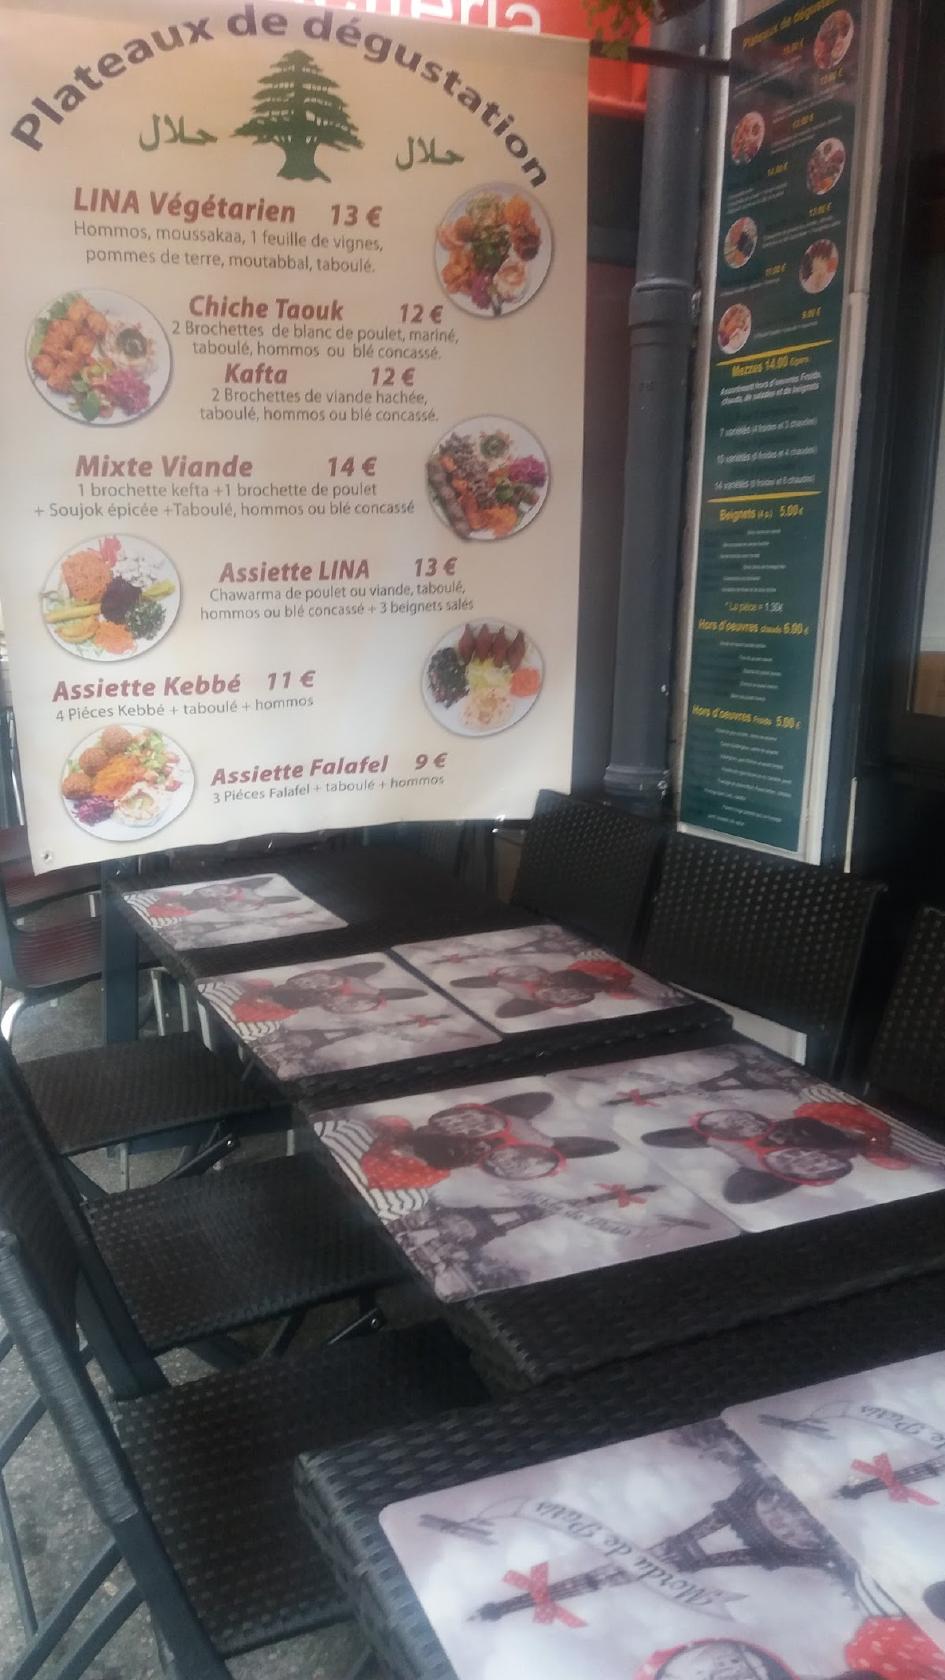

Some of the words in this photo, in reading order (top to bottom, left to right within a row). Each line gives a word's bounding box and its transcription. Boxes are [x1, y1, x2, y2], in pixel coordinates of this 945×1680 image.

[10, 16, 215, 152] Plateaux
[227, 4, 288, 37] de
[303, 11, 547, 188] dégustation
[73, 187, 140, 214] LINA
[150, 191, 296, 224] Végétarien
[331, 204, 359, 227] 13
[366, 205, 383, 228] €
[73, 220, 151, 241] Hommos,
[156, 227, 246, 246] moussakaa,
[262, 229, 307, 248] feuille
[311, 233, 328, 249] de
[333, 235, 384, 254] vignes,
[86, 249, 155, 265] pommes
[160, 249, 179, 264] de
[185, 252, 225, 268] terre,
[229, 253, 313, 272] moutabbal,
[317, 257, 376, 273] taboulé.
[189, 294, 269, 319] Chiche
[275, 298, 344, 321] Taouk
[400, 303, 424, 323] 12
[429, 304, 444, 324] €
[172, 320, 181, 335] 2
[185, 320, 264, 337] Brochettes
[271, 323, 289, 339] de
[294, 324, 332, 340] blanc
[336, 324, 353, 340] de
[358, 325, 405, 343] poulet,
[409, 328, 459, 344] mariné,
[193, 340, 253, 357] taboulé,
[257, 341, 320, 358] hommos
[327, 345, 345, 358] ou
[353, 343, 374, 359] blé
[378, 345, 442, 361] concassé.
[224, 362, 288, 384] Kafta
[371, 365, 396, 386] 12
[401, 366, 416, 387] €
[211, 387, 220, 402] 2
[224, 387, 301, 403] Brochettes
[304, 389, 322, 403] de
[326, 389, 373, 404] viande
[376, 389, 428, 406] hachée,
[200, 405, 260, 422] taboulé,
[263, 406, 325, 421] hommos
[329, 408, 347, 421] ou
[351, 406, 372, 421] blé
[375, 407, 440, 422] concassé.
[75, 454, 153, 478] Mixte
[161, 454, 253, 478] Viande
[328, 456, 355, 477] 14
[361, 456, 378, 478] €
[91, 482, 167, 497] brochette
[171, 482, 209, 497] kefta
[237, 482, 307, 498] brochette
[311, 482, 328, 497] de
[333, 482, 376, 499] poulet
[49, 502, 103, 520] Soujok
[108, 502, 158, 520] épicée
[241, 501, 304, 517] hommos
[308, 504, 326, 516] ou
[330, 500, 351, 515] blé
[354, 500, 415, 515] concassé
[219, 561, 313, 583] Assiette
[319, 559, 370, 581] LINA
[415, 558, 438, 577] 13
[443, 556, 458, 576] €
[210, 588, 281, 602] Chawarma
[285, 586, 301, 600] de
[305, 585, 346, 602] poulet
[350, 586, 366, 598] ou
[369, 583, 414, 598] viande,
[416, 580, 466, 595] taboulé,
[200, 606, 260, 620] hommos
[263, 607, 281, 619] ou
[284, 604, 304, 618] blé
[308, 602, 364, 617] concassé
[380, 601, 387, 614] 3
[390, 599, 443, 616] beignets
[446, 597, 474, 612] salés
[52, 677, 156, 702] Assiette
[164, 674, 241, 696] Kebbé
[267, 671, 292, 691] 11
[299, 669, 316, 688] €
[56, 709, 64, 721] 4
[118, 702, 165, 717] Kebbé
[183, 700, 238, 715] taboulé
[255, 696, 314, 711] hommos
[210, 764, 304, 786] Assiette
[309, 754, 389, 777] Falafel
[414, 754, 429, 771] 9
[433, 752, 449, 769] €
[213, 792, 221, 804] 3
[269, 783, 310, 798] Falafel
[326, 780, 375, 793] taboulé
[390, 775, 444, 789] hommos
[603, 1533, 632, 1557] de
